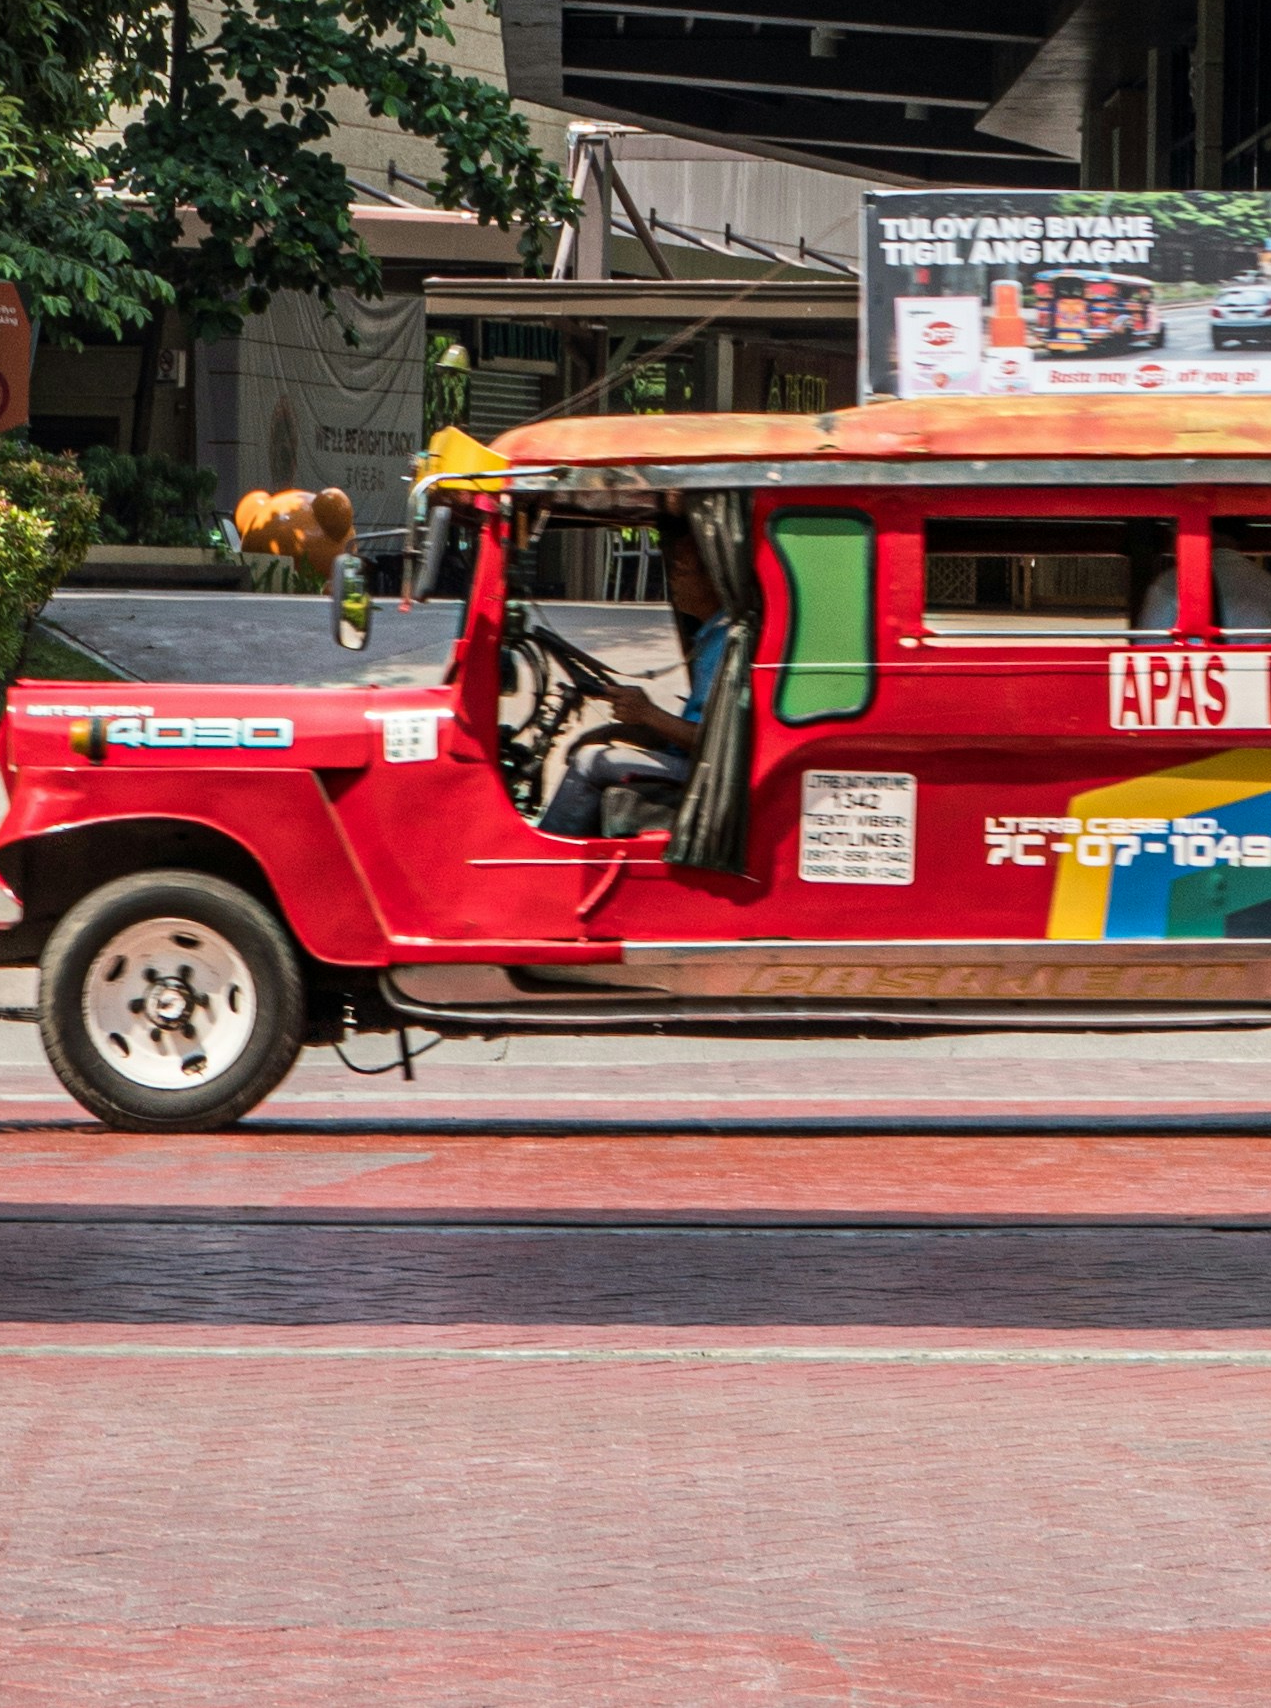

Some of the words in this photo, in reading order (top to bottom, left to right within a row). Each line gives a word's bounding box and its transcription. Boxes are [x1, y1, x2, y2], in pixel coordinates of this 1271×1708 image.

[878, 217, 977, 240] TULOY
[976, 217, 1044, 239] ANG
[879, 241, 963, 265] TIGIL
[968, 241, 1041, 264] ANG
[1042, 240, 1155, 263] KAGAT
[1117, 655, 1227, 725] APAS
[831, 792, 882, 809] 1342
[985, 817, 1083, 834] LTFRB
[1172, 818, 1228, 835] NO.
